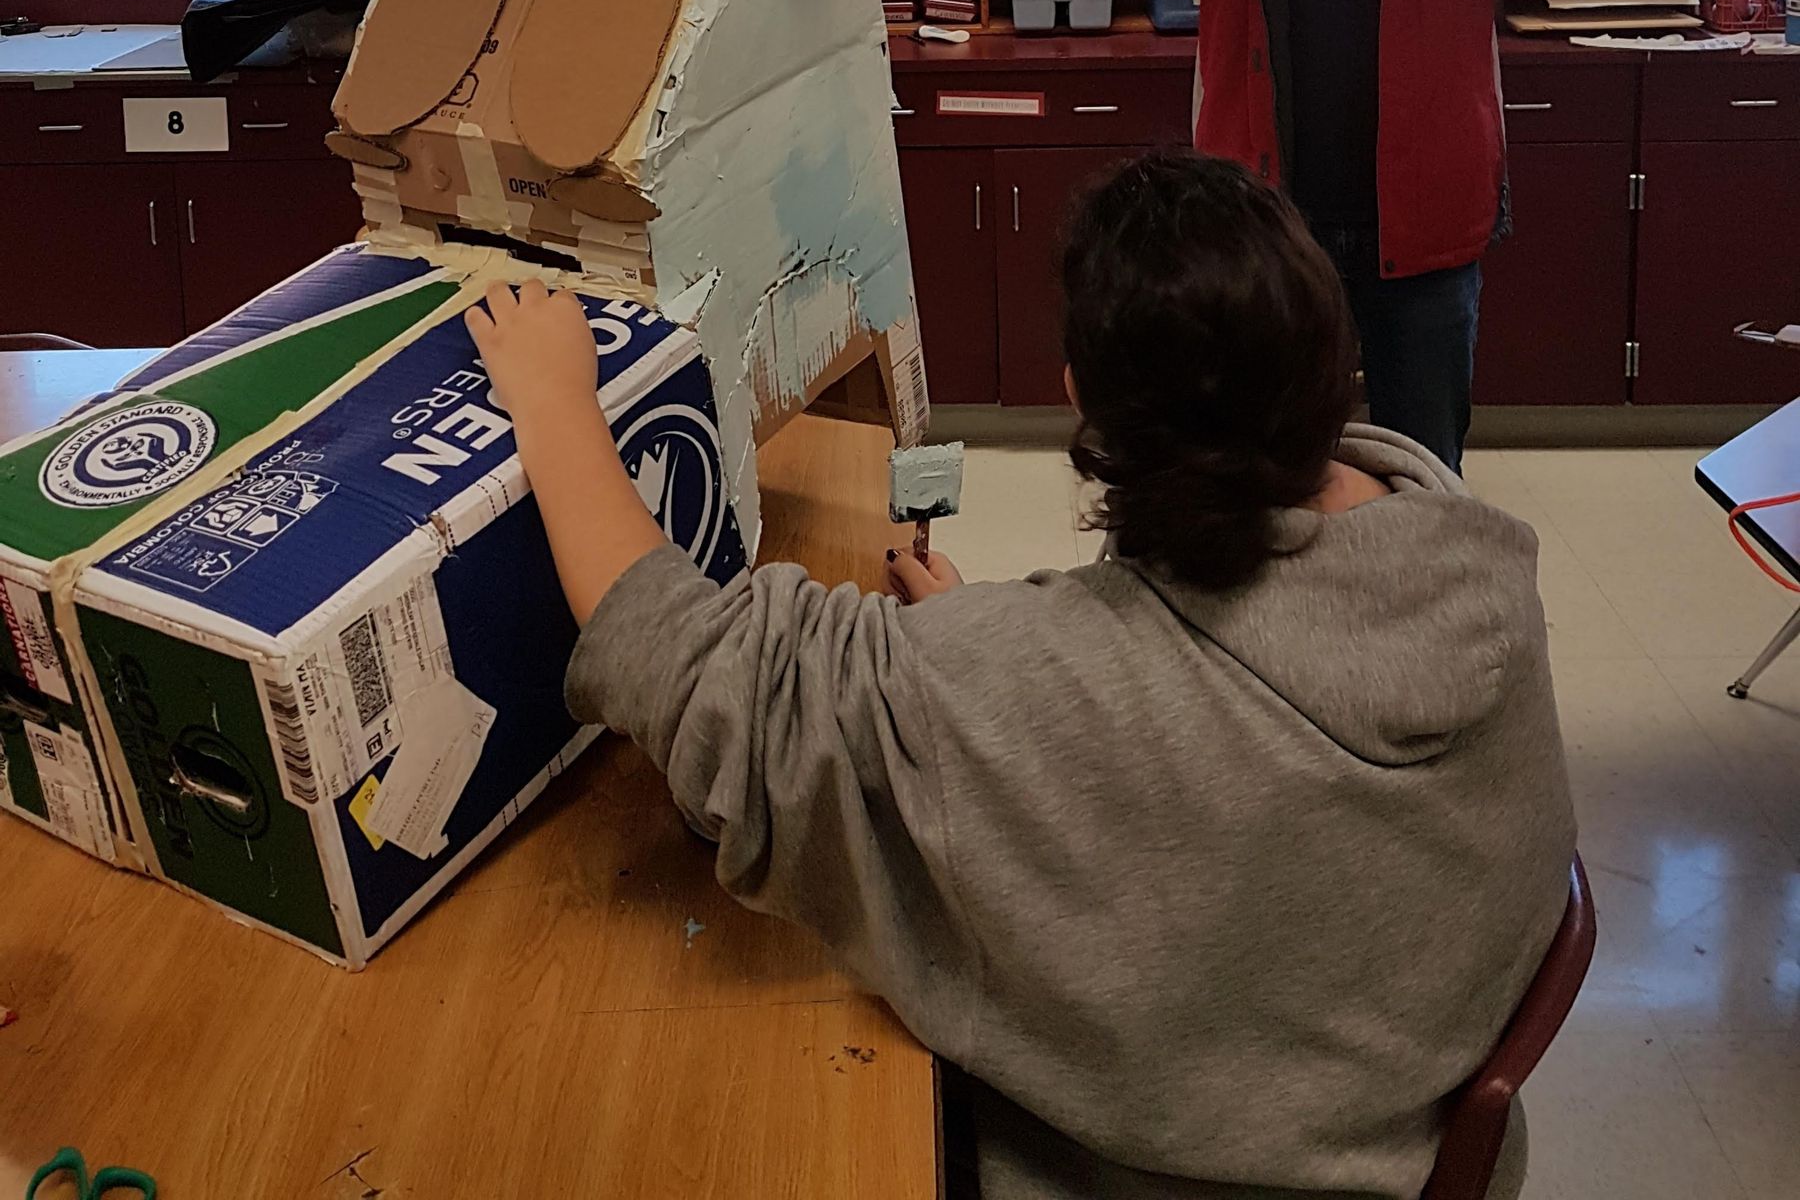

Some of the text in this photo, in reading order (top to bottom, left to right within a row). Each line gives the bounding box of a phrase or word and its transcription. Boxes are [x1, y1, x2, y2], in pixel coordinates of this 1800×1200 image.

[167, 111, 184, 135] 8
[437, 109, 466, 120] UCE
[508, 177, 548, 199] OPEN
[55, 405, 184, 472] GOLDEN STANDARD
[59, 416, 211, 500] ENVIRONMENTALLY SOCIALLY RESPONSIBLE
[142, 450, 188, 483] CERTIFIED
[208, 490, 230, 504] OF
[113, 504, 205, 564] COLOMBIA
